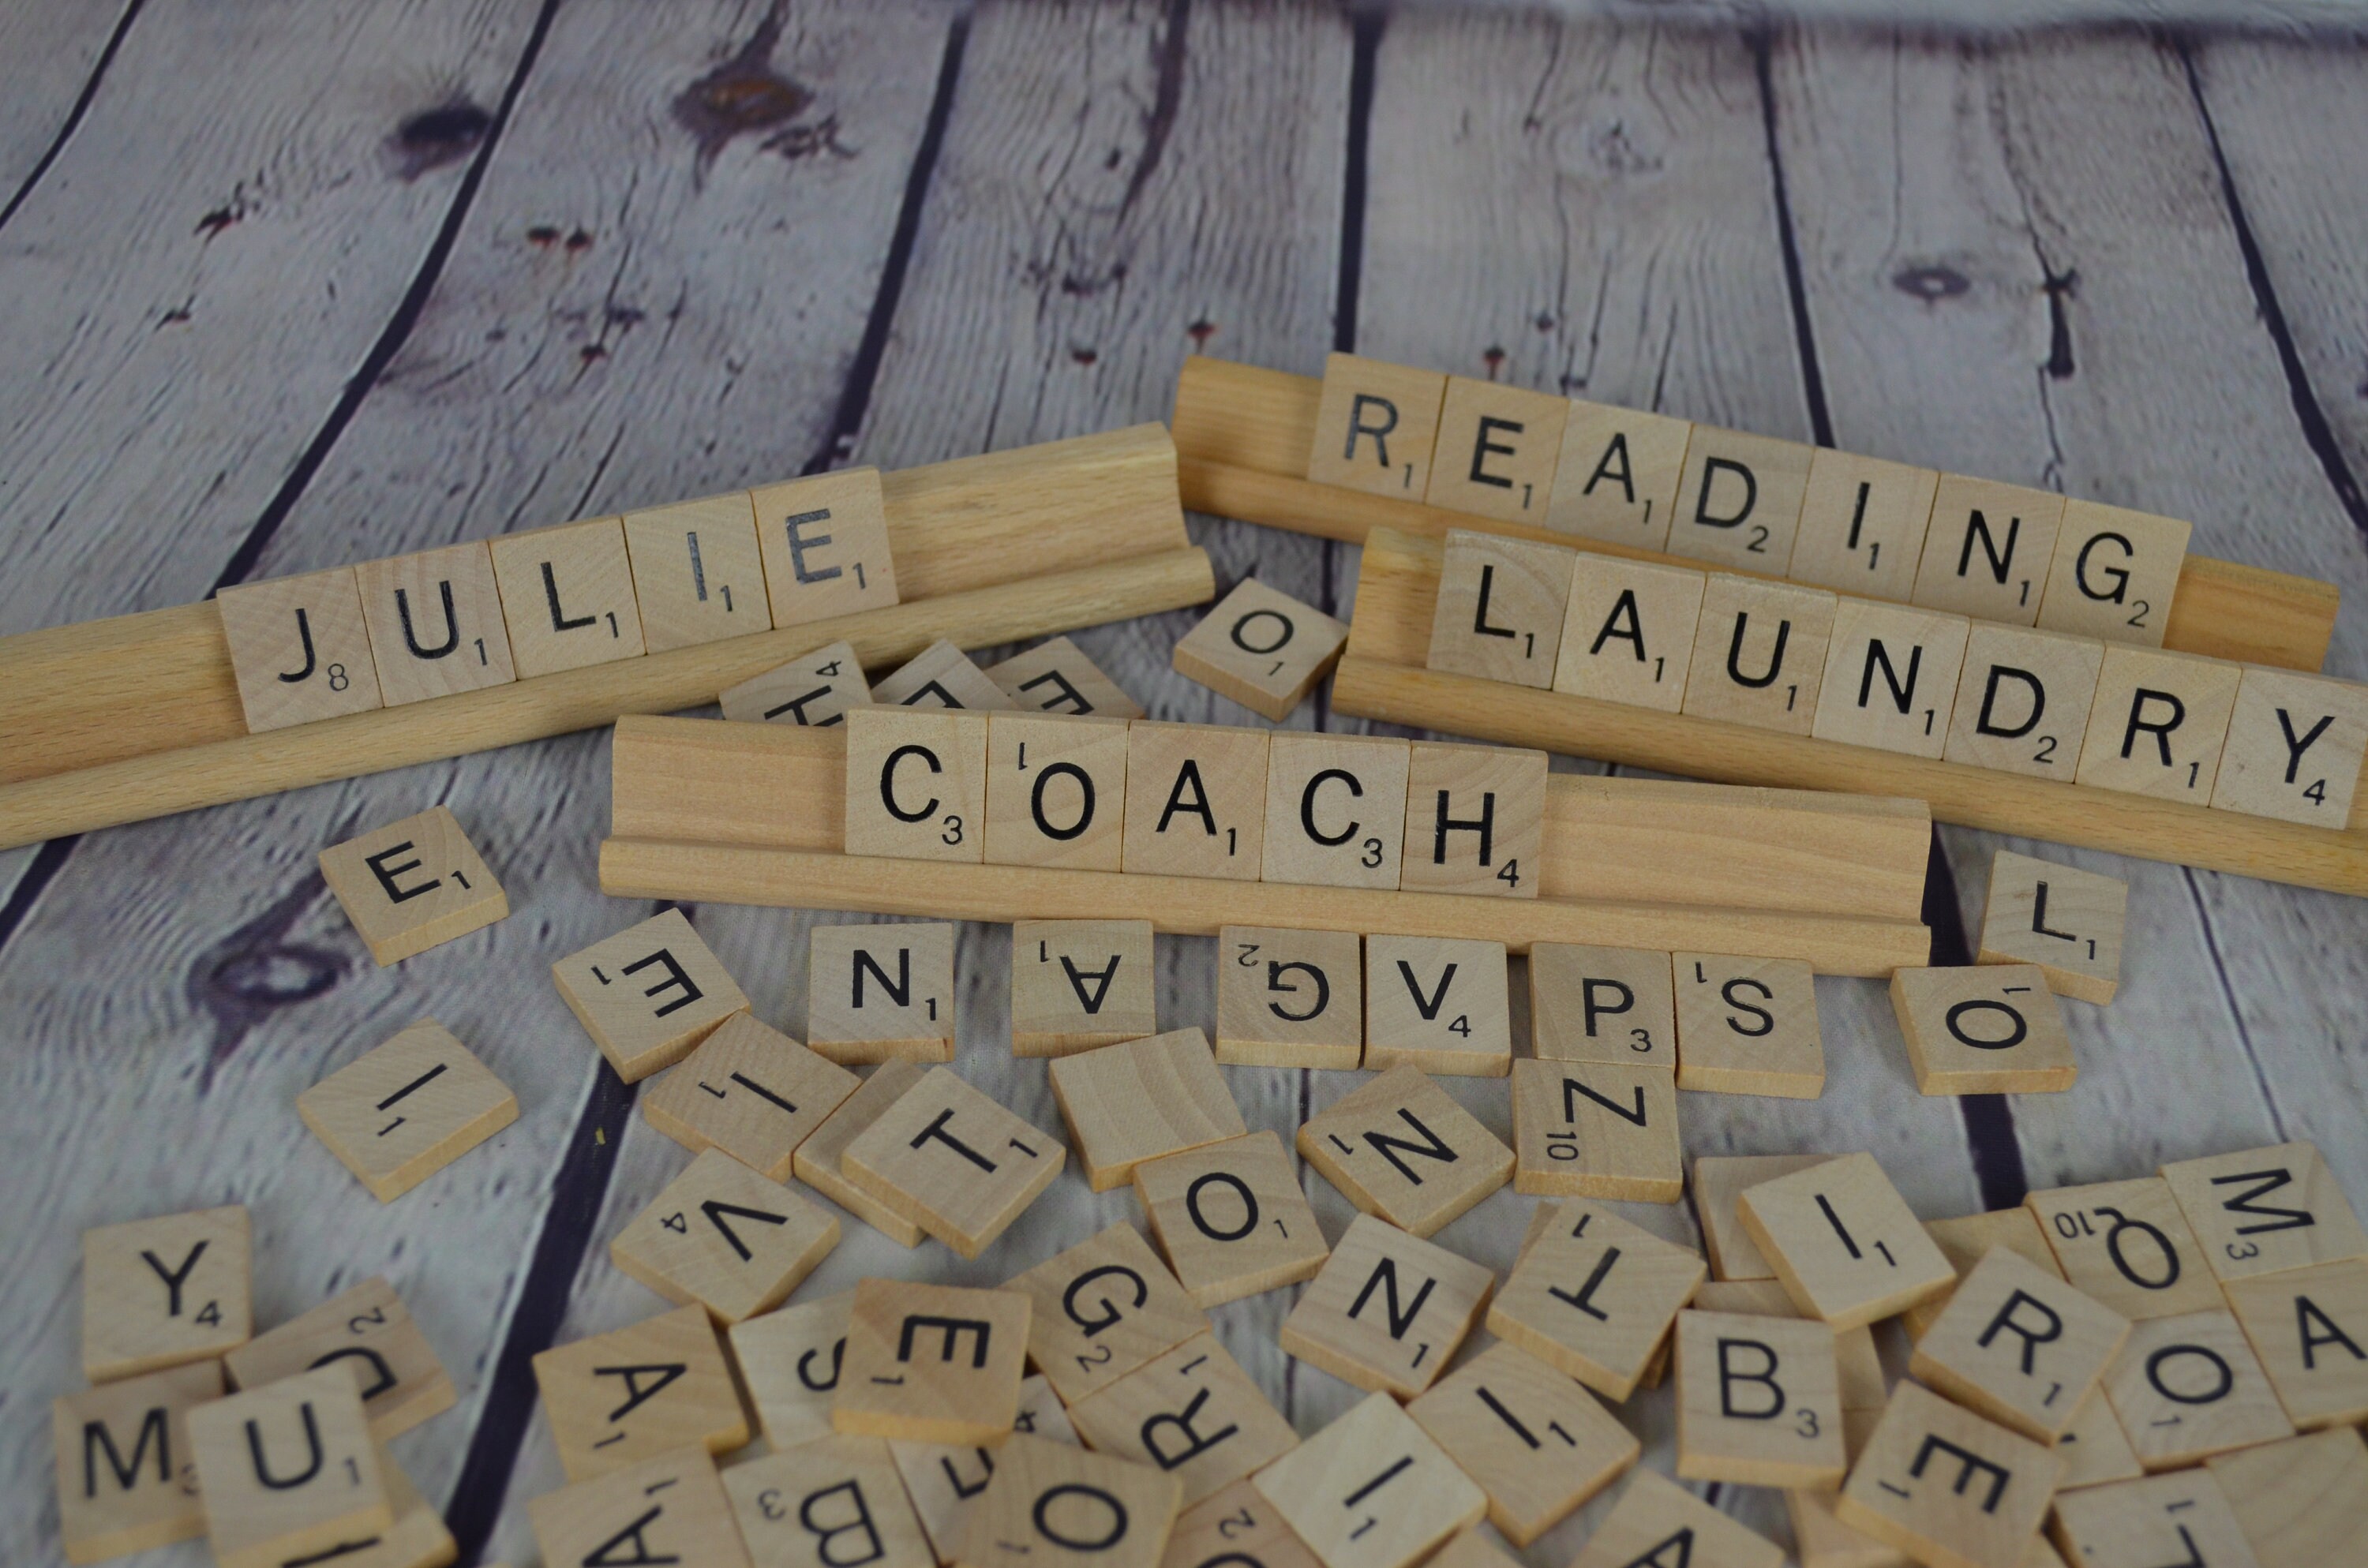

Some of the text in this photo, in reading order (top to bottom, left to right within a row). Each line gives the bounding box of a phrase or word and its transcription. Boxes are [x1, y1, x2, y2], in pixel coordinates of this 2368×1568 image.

[1344, 394, 2133, 604] READING
[1404, 463, 1413, 488] 1
[1523, 484, 1532, 510] 1
[1643, 500, 1652, 524] 1
[1747, 526, 1769, 553] 2
[852, 563, 866, 589] 1
[1869, 543, 1879, 570] 1
[278, 508, 842, 683] JULIE
[721, 586, 733, 612] 1
[2020, 580, 2029, 607] 1
[2127, 601, 2149, 628] 2
[474, 638, 487, 665] 1
[605, 612, 618, 638] 1
[1231, 610, 1294, 654] O
[1526, 633, 1534, 658] 1
[328, 663, 349, 691] 8
[1474, 565, 2335, 784] LAUNDRY
[1656, 657, 1664, 683] 1
[1787, 685, 1797, 711] 1
[1925, 709, 1934, 735] 1
[2033, 736, 2057, 763] 2
[1018, 743, 1027, 770] 1
[2189, 762, 2199, 788] 1
[880, 745, 1494, 866] COACH
[2303, 780, 2325, 806] 4
[942, 815, 962, 845] 3
[1227, 828, 1236, 855] 1
[1362, 838, 1382, 868] 3
[365, 840, 441, 904] E
[1497, 859, 1519, 888] 4
[2032, 881, 2076, 941] L
[621, 949, 703, 1017] E
[852, 949, 909, 1008] N
[1059, 955, 1121, 1014] A
[1268, 960, 1329, 1021] G
[1397, 960, 1457, 1020] V
[1583, 978, 1634, 1037] P
[1722, 979, 1774, 1036] S
[1946, 1000, 2027, 1050] O
[377, 1064, 448, 1111] I
[730, 1072, 797, 1113] I
[1563, 1078, 1646, 1127] Z
[909, 1109, 997, 1173] T
[1362, 1108, 1459, 1185] N
[701, 1200, 788, 1262] V
[1186, 1173, 1258, 1241] O
[1815, 1194, 1862, 1259] I
[2211, 1169, 2315, 1235] M
[2093, 1207, 2180, 1289] Q
[141, 1241, 208, 1316] Y
[1062, 1266, 1148, 1338] G
[1347, 1257, 1437, 1341] N
[1548, 1247, 1621, 1321] T
[897, 1315, 991, 1368] E
[1977, 1289, 2063, 1375] R
[2295, 1296, 2368, 1369] A
[594, 1363, 687, 1422] A
[1718, 1338, 1785, 1420] B
[2145, 1345, 2234, 1405] O
[245, 1403, 324, 1491] U
[1141, 1388, 1238, 1473] R
[1476, 1387, 1541, 1450] I
[83, 1407, 172, 1499] M
[1344, 1456, 1414, 1508] I
[1909, 1434, 2010, 1514] E
[582, 1506, 680, 1568] A
[799, 1479, 885, 1568] B
[1032, 1484, 1128, 1552] O
